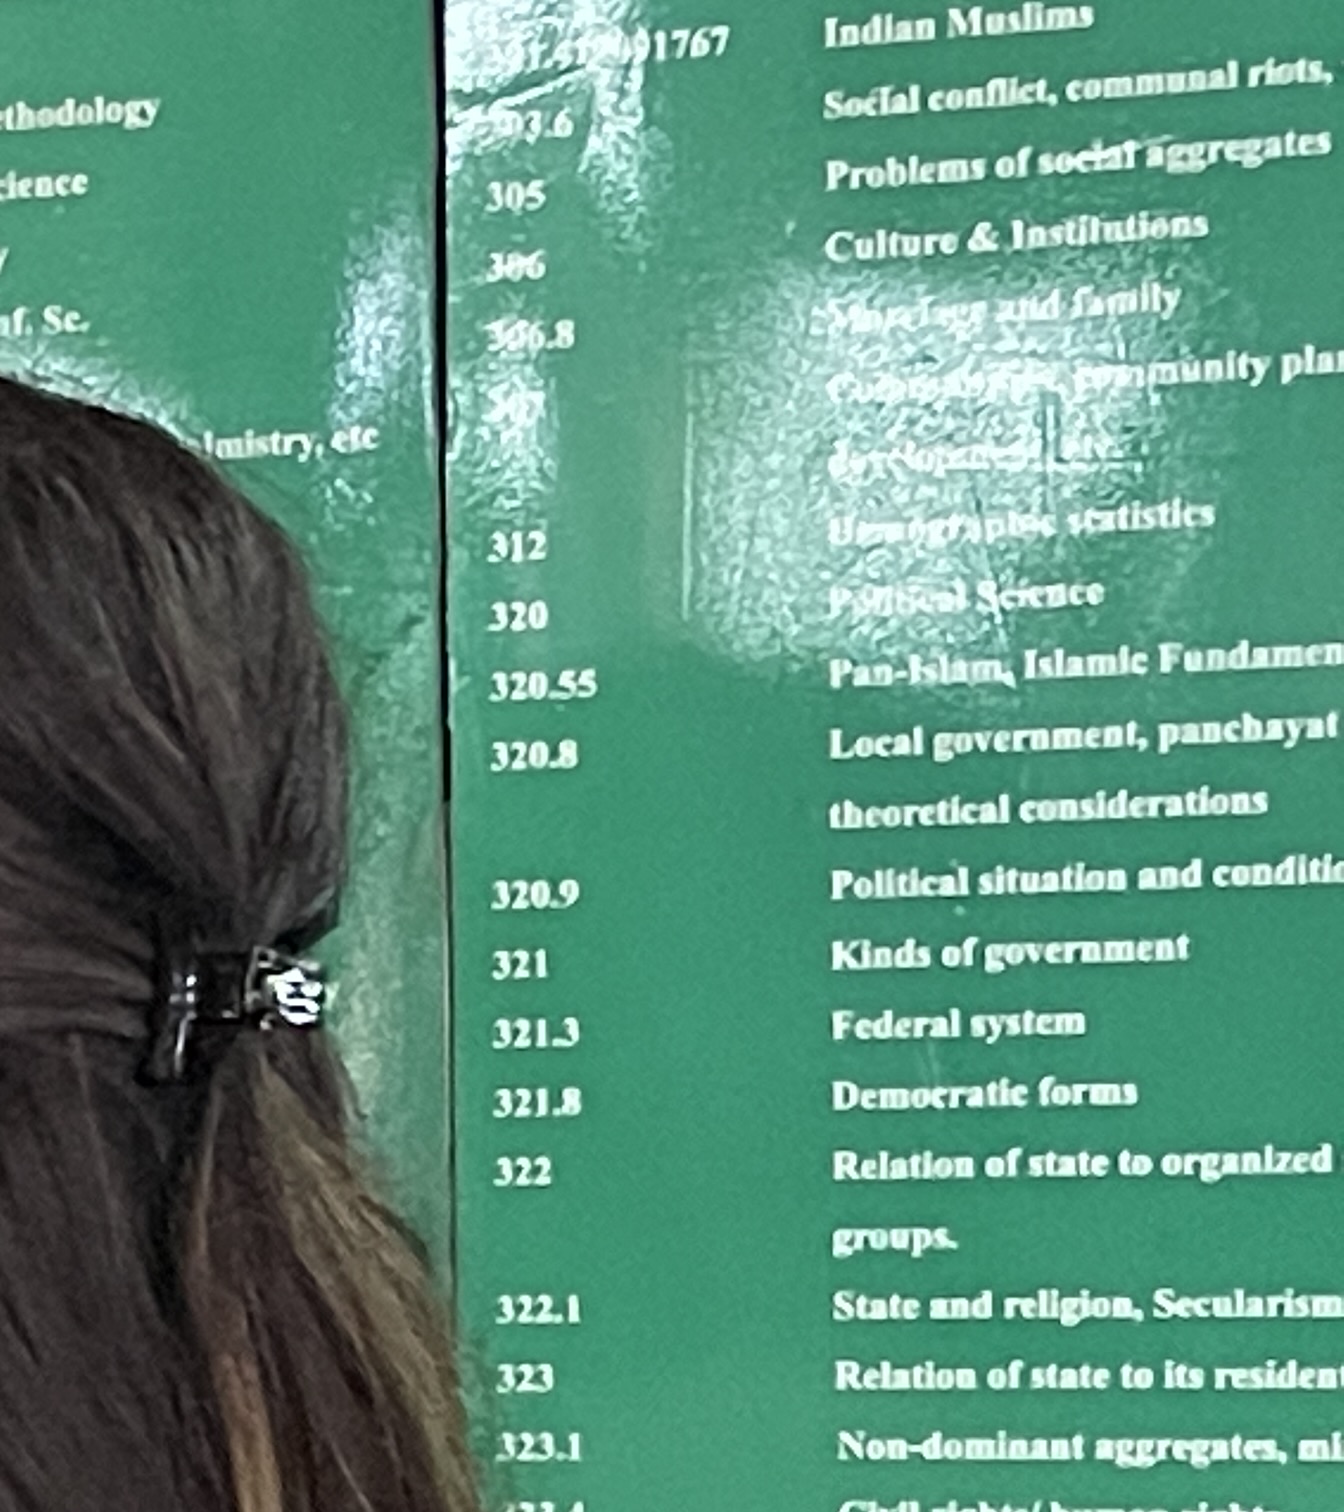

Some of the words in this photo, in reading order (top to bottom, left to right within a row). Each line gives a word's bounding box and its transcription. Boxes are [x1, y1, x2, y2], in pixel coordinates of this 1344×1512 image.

[824, 13, 936, 48] Indian
[947, 1, 1095, 38] Muslims
[823, 84, 921, 119] Social
[927, 76, 1058, 112] conflict,
[1065, 59, 1239, 102] communal
[1247, 57, 1334, 88] riots,
[826, 155, 986, 191] Problems
[994, 145, 1033, 179] of
[1038, 139, 1137, 175] social
[1144, 130, 1332, 174] aggregates
[485, 179, 547, 213] 305
[823, 228, 959, 264] Culture
[967, 221, 999, 253] &
[1007, 210, 1209, 253] Institutions
[485, 249, 546, 283] 306
[995, 288, 1060, 321] and
[1069, 281, 1182, 322] family
[42, 305, 90, 335] Sc.
[190, 428, 324, 463] lmistry,
[1066, 496, 1217, 537] statistics
[487, 526, 547, 564] 312
[976, 580, 1106, 613] Science
[487, 599, 549, 632] 320
[489, 668, 598, 702] 320.55
[829, 652, 1017, 692] Pan-Islam,
[1024, 644, 1149, 680] Islamic
[829, 725, 924, 759] Local
[933, 720, 1149, 762] government,
[1157, 710, 1339, 754] panchayat
[490, 739, 579, 772] 320.8
[829, 793, 1010, 829] theoretical
[1018, 785, 1269, 824] considerations
[491, 879, 580, 910] 320.9
[831, 866, 970, 900] Political
[978, 862, 1128, 895] situation
[1137, 857, 1203, 890] and
[492, 948, 547, 981] 321
[831, 937, 932, 971] Kinds
[941, 936, 979, 968] of
[984, 933, 1190, 973] government
[492, 1016, 580, 1049] 321.3
[832, 1007, 961, 1041] Federal
[970, 1009, 1086, 1045] system
[492, 1086, 582, 1118] 321.8
[832, 1077, 1029, 1111] Democratic
[1038, 1075, 1138, 1107] forms
[493, 1155, 552, 1187] 322
[833, 1150, 975, 1181] Relation
[984, 1147, 1023, 1178] of
[1028, 1150, 1110, 1177] state
[1118, 1149, 1154, 1176] to
[1160, 1142, 1333, 1183] organized
[832, 1227, 958, 1258] groups.
[495, 1293, 580, 1325] 322.1
[832, 1290, 921, 1321] State
[929, 1289, 993, 1320] and
[1003, 1288, 1145, 1327] religion,
[1152, 1287, 1344, 1319] Secularism
[495, 1363, 554, 1394] 323
[834, 1360, 977, 1391] Relation
[986, 1359, 1025, 1390] of
[1030, 1363, 1111, 1390] state
[1119, 1363, 1154, 1390] to
[1163, 1359, 1205, 1390] its
[495, 1431, 581, 1462] 323.1
[837, 1430, 1085, 1461] Non-dominant
[1094, 1433, 1288, 1469] aggregates,
